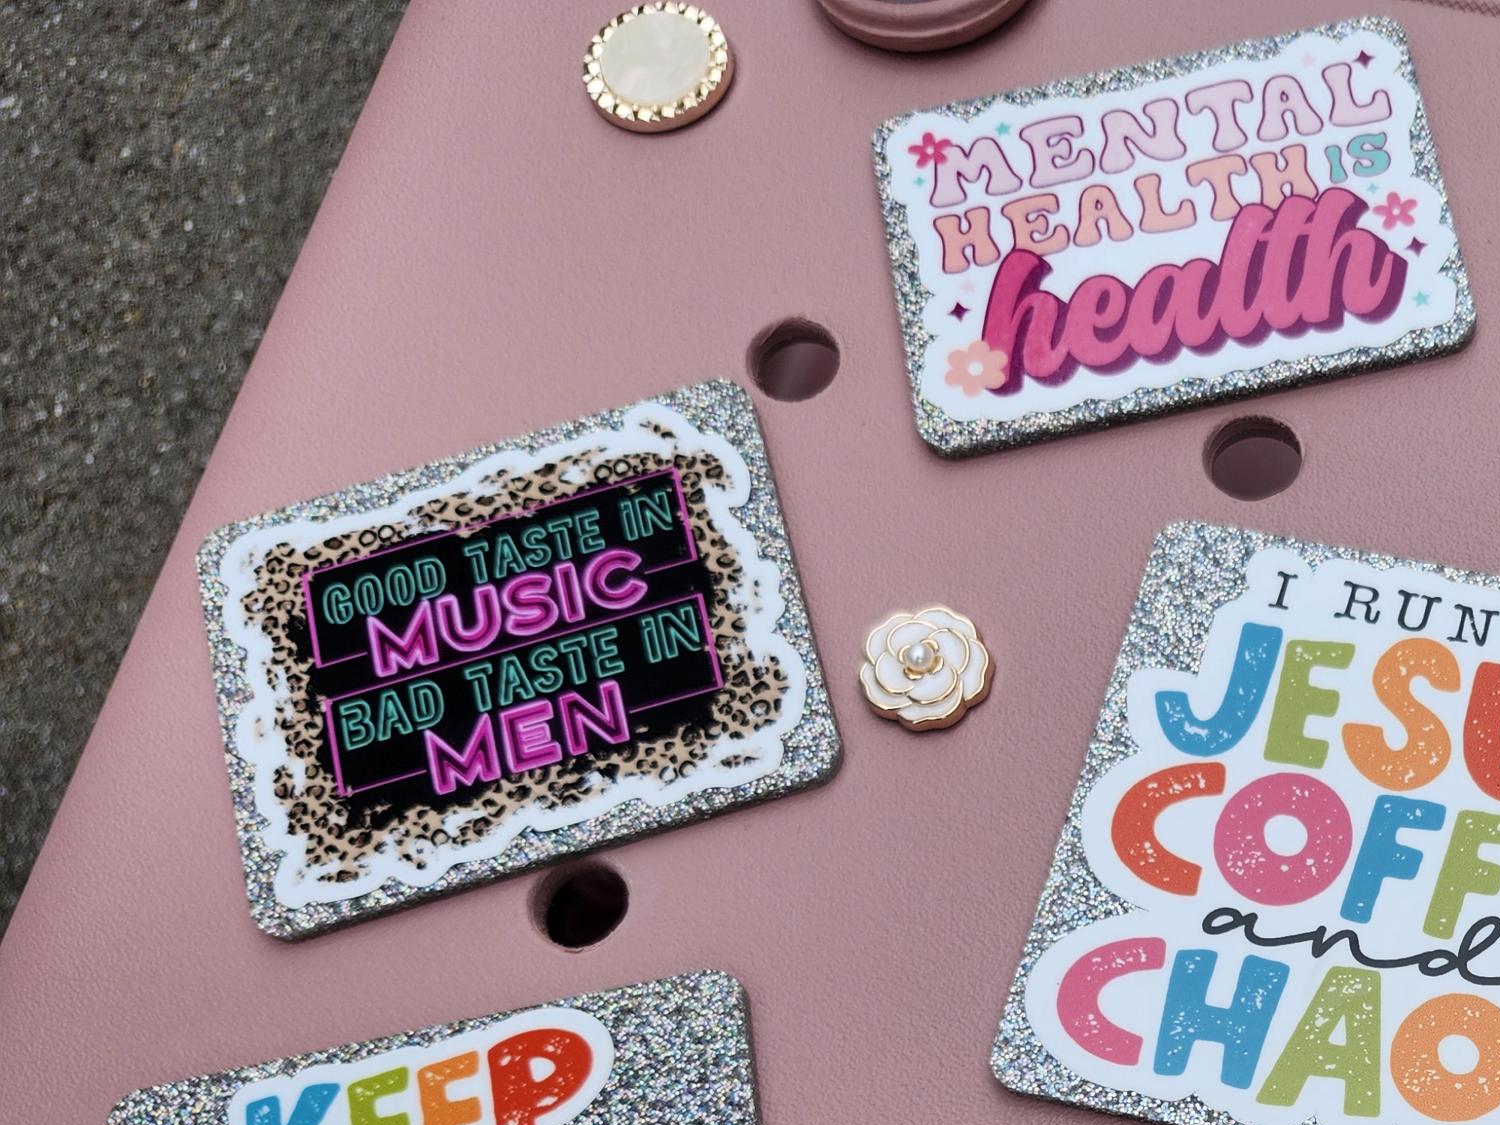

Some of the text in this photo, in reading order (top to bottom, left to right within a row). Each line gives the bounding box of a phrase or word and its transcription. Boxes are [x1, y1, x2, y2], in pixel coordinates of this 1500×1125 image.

[930, 62, 1392, 208] MENTAL
[933, 131, 1391, 275] HEALTH IS
[981, 187, 1408, 398] health
[322, 555, 447, 626] GOOD
[463, 508, 605, 585] TASTE
[366, 549, 648, 678] MUSIC
[1267, 572, 1298, 609] I
[1334, 581, 1500, 647] RUN
[339, 680, 444, 751] BAD
[465, 628, 625, 712] TASTE
[424, 681, 630, 796] MEN
